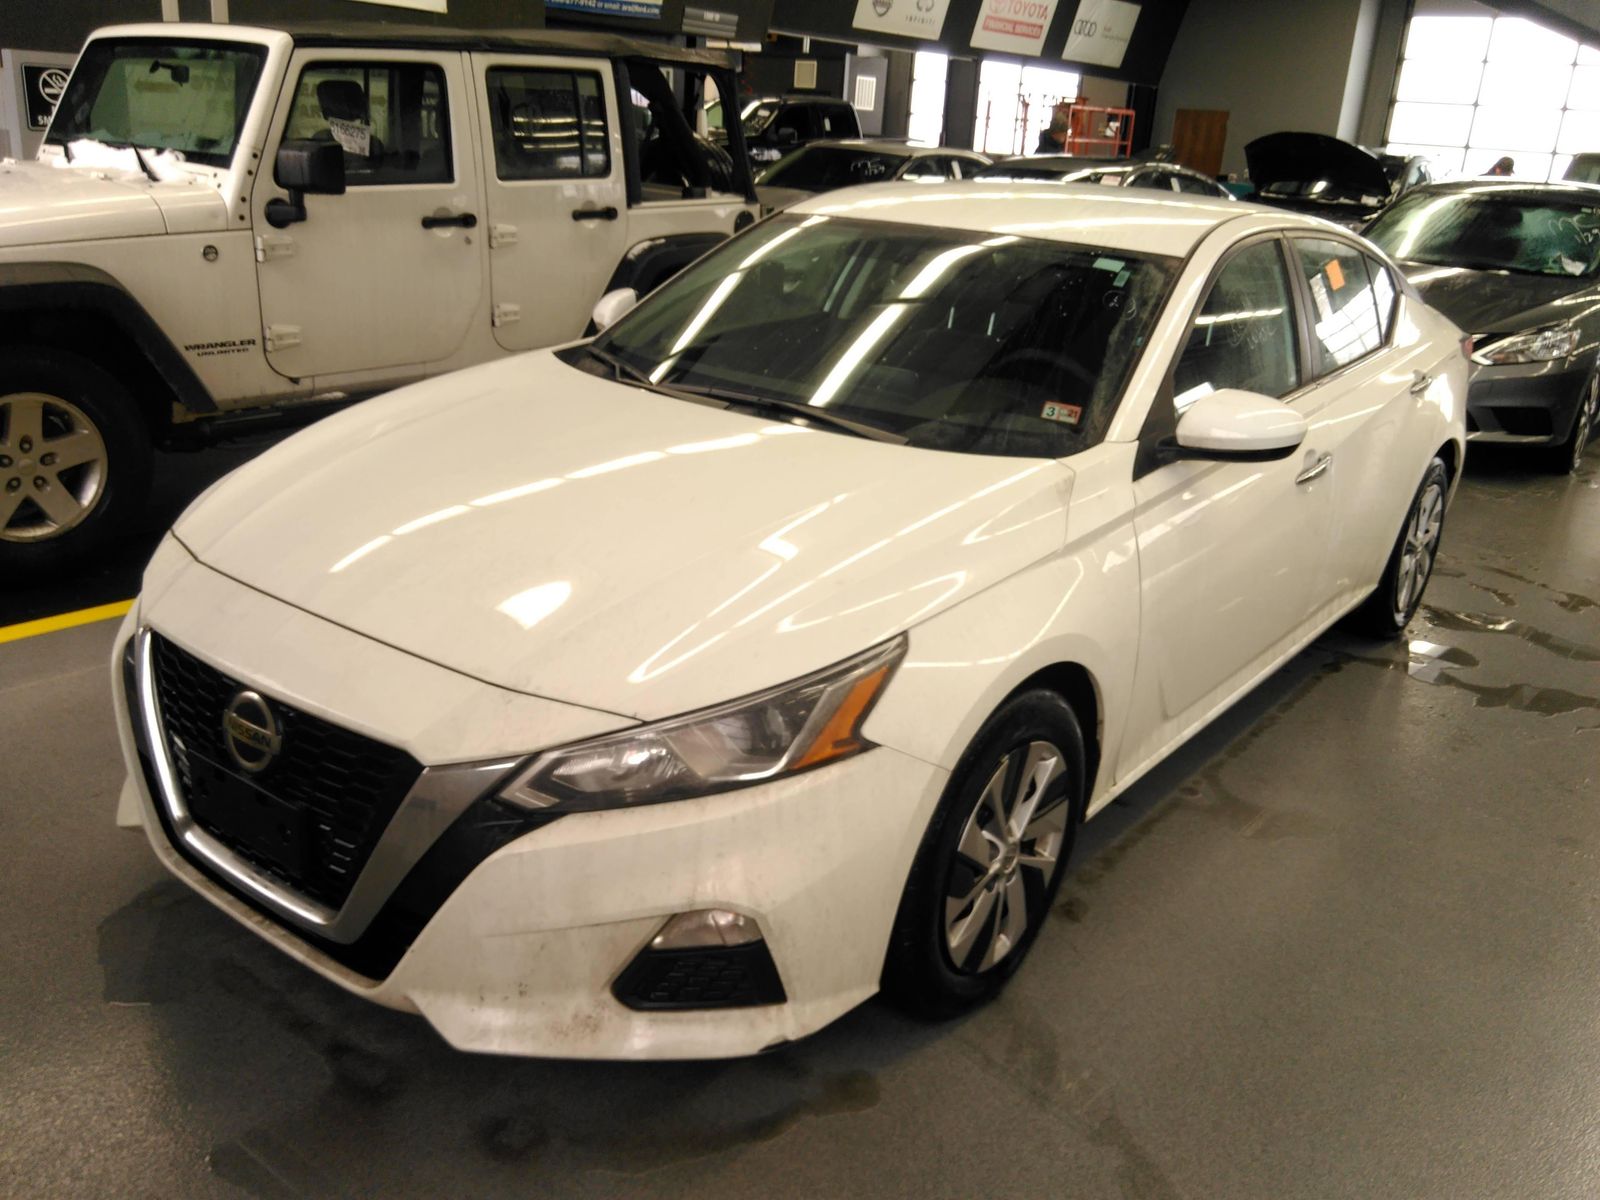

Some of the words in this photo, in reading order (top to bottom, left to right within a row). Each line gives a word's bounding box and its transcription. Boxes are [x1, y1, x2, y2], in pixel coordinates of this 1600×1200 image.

[1006, 0, 1049, 20] TOYOTA
[183, 339, 256, 351] WRANGLER
[1046, 406, 1056, 417] 3
